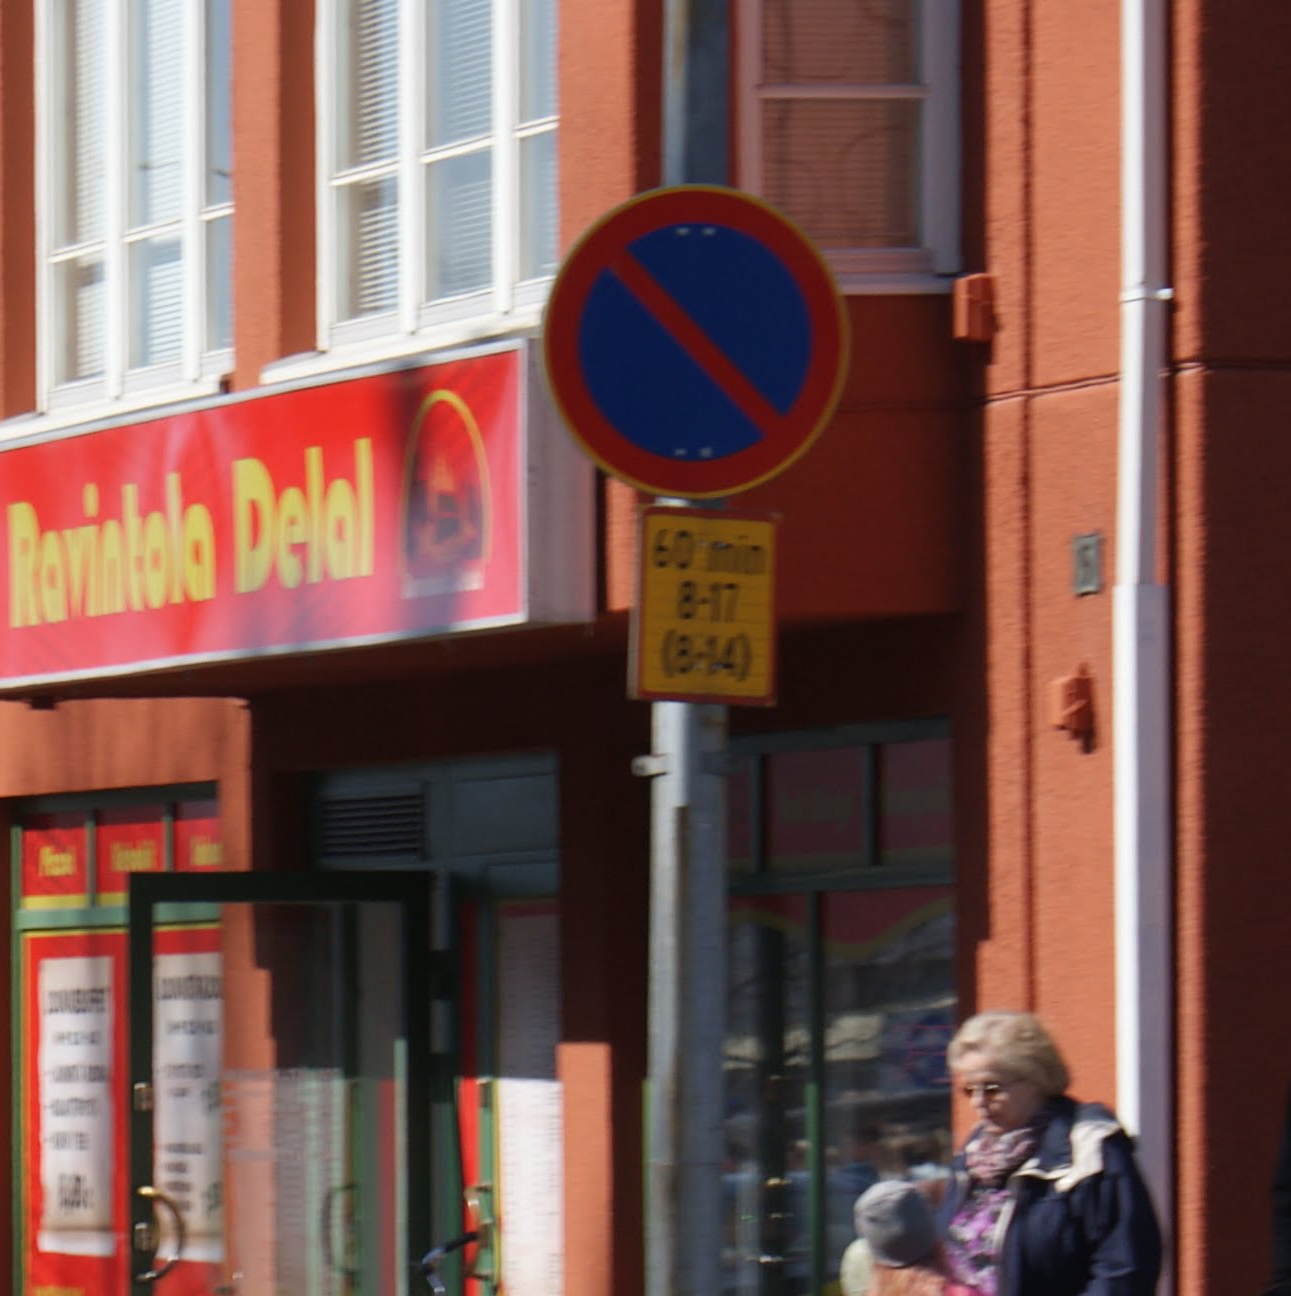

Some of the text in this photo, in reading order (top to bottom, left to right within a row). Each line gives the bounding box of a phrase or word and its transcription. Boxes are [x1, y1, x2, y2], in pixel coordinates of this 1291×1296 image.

[7, 437, 374, 629] Ravintola Delal
[652, 529, 765, 576] 60 min
[677, 580, 739, 623] 8-17
